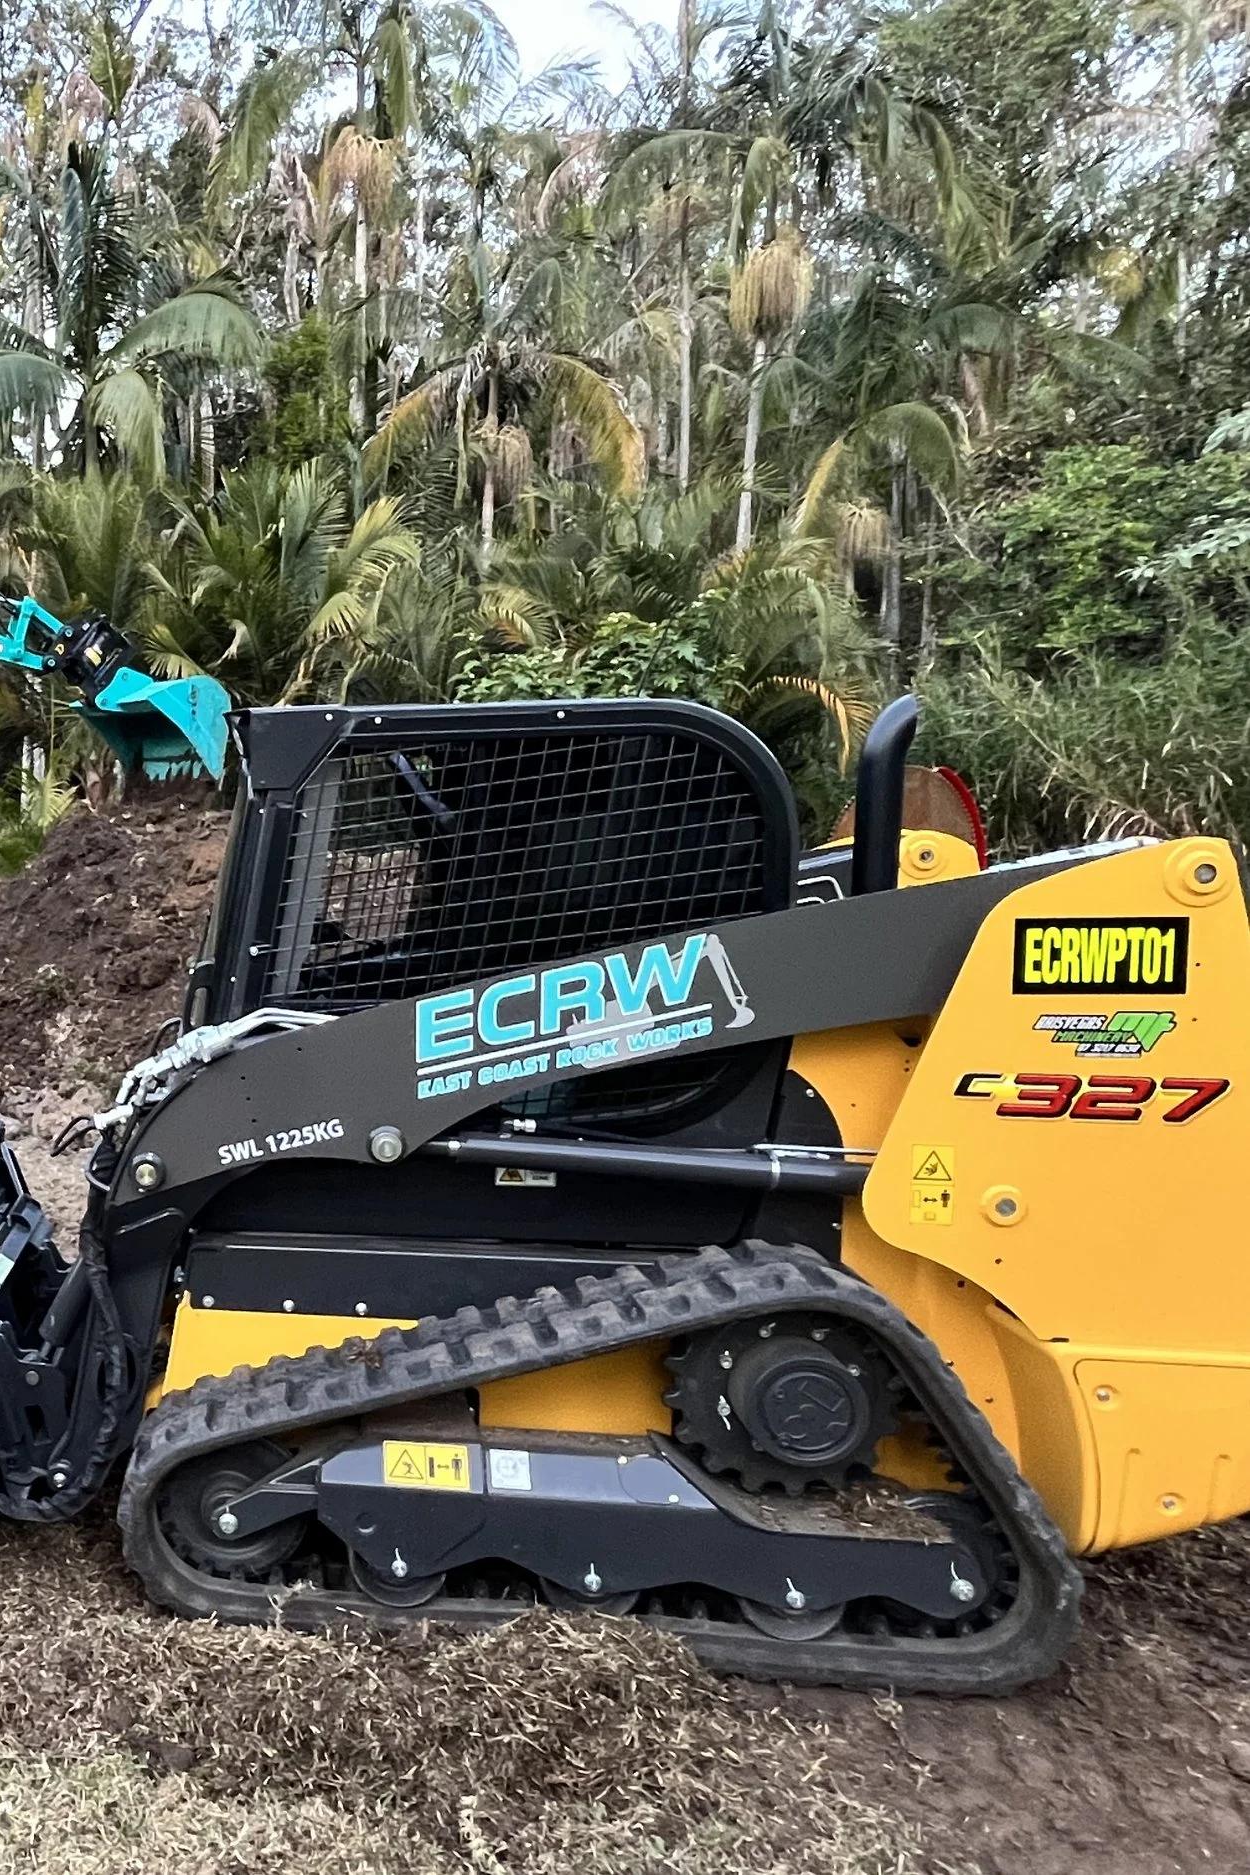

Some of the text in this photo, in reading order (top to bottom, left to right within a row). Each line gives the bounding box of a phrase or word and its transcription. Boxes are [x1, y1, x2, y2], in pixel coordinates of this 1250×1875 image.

[1024, 926, 1176, 984] ECRWPT01
[416, 933, 707, 1063] ECRW
[417, 1016, 713, 1100] EAST COAST ROCK WORKS
[218, 1118, 345, 1165] SWL 1225KG
